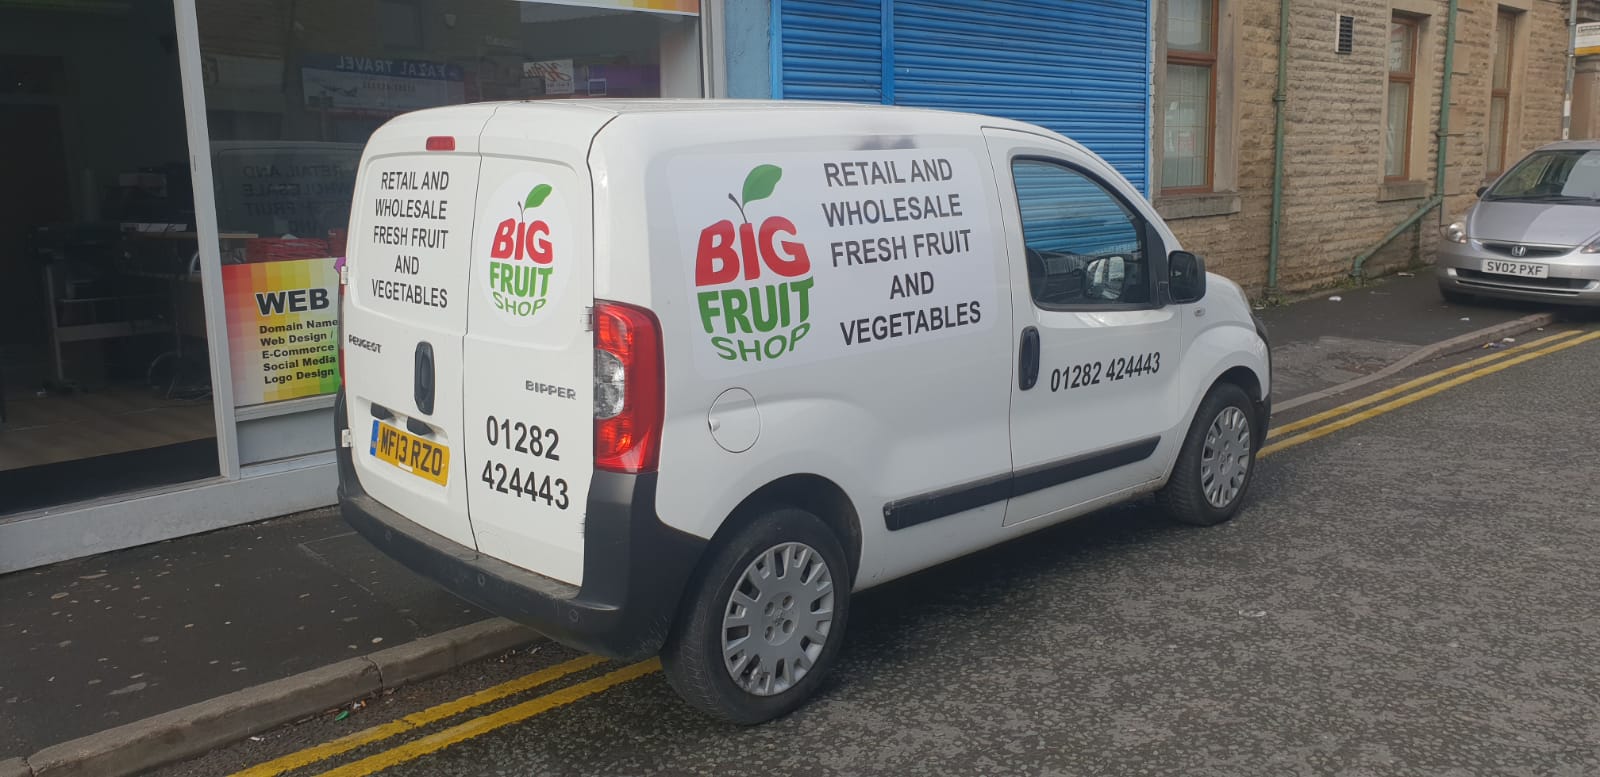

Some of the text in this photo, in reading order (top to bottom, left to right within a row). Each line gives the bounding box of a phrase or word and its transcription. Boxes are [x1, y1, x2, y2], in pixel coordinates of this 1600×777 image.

[381, 171, 449, 190] RETAIL AND
[824, 158, 953, 188] RETAIL AND
[375, 199, 448, 220] WHOLESALE
[822, 194, 963, 227] WHOLESALE
[373, 226, 449, 249] FRESH FRUIT
[491, 218, 553, 264] BIG
[695, 215, 811, 286] BIG
[830, 229, 971, 267] FRESH FRUIT
[394, 255, 420, 275] AND
[1488, 261, 1543, 276] SV02 PXF
[371, 278, 448, 308] VEGETABLES
[489, 262, 553, 297] FRUIT
[889, 271, 934, 299] AND
[256, 288, 330, 315] WEB
[492, 291, 547, 317] SHOP
[697, 276, 814, 335] FRUIT
[259, 318, 338, 334] Domain Name
[840, 301, 982, 345] VEGETABLES
[260, 334, 285, 346] Web
[289, 331, 327, 345] Design
[262, 344, 335, 359] E-Commerce
[348, 334, 382, 353] PEUGEOT
[711, 322, 811, 362] SHOP
[263, 355, 336, 371] Social Media
[264, 368, 334, 384] Logo Design
[1051, 351, 1161, 392] 01282 424443
[526, 380, 576, 400] BIPPER
[380, 427, 443, 476] MF13 RZO
[486, 415, 560, 461] 01282
[482, 459, 569, 510] 424443
